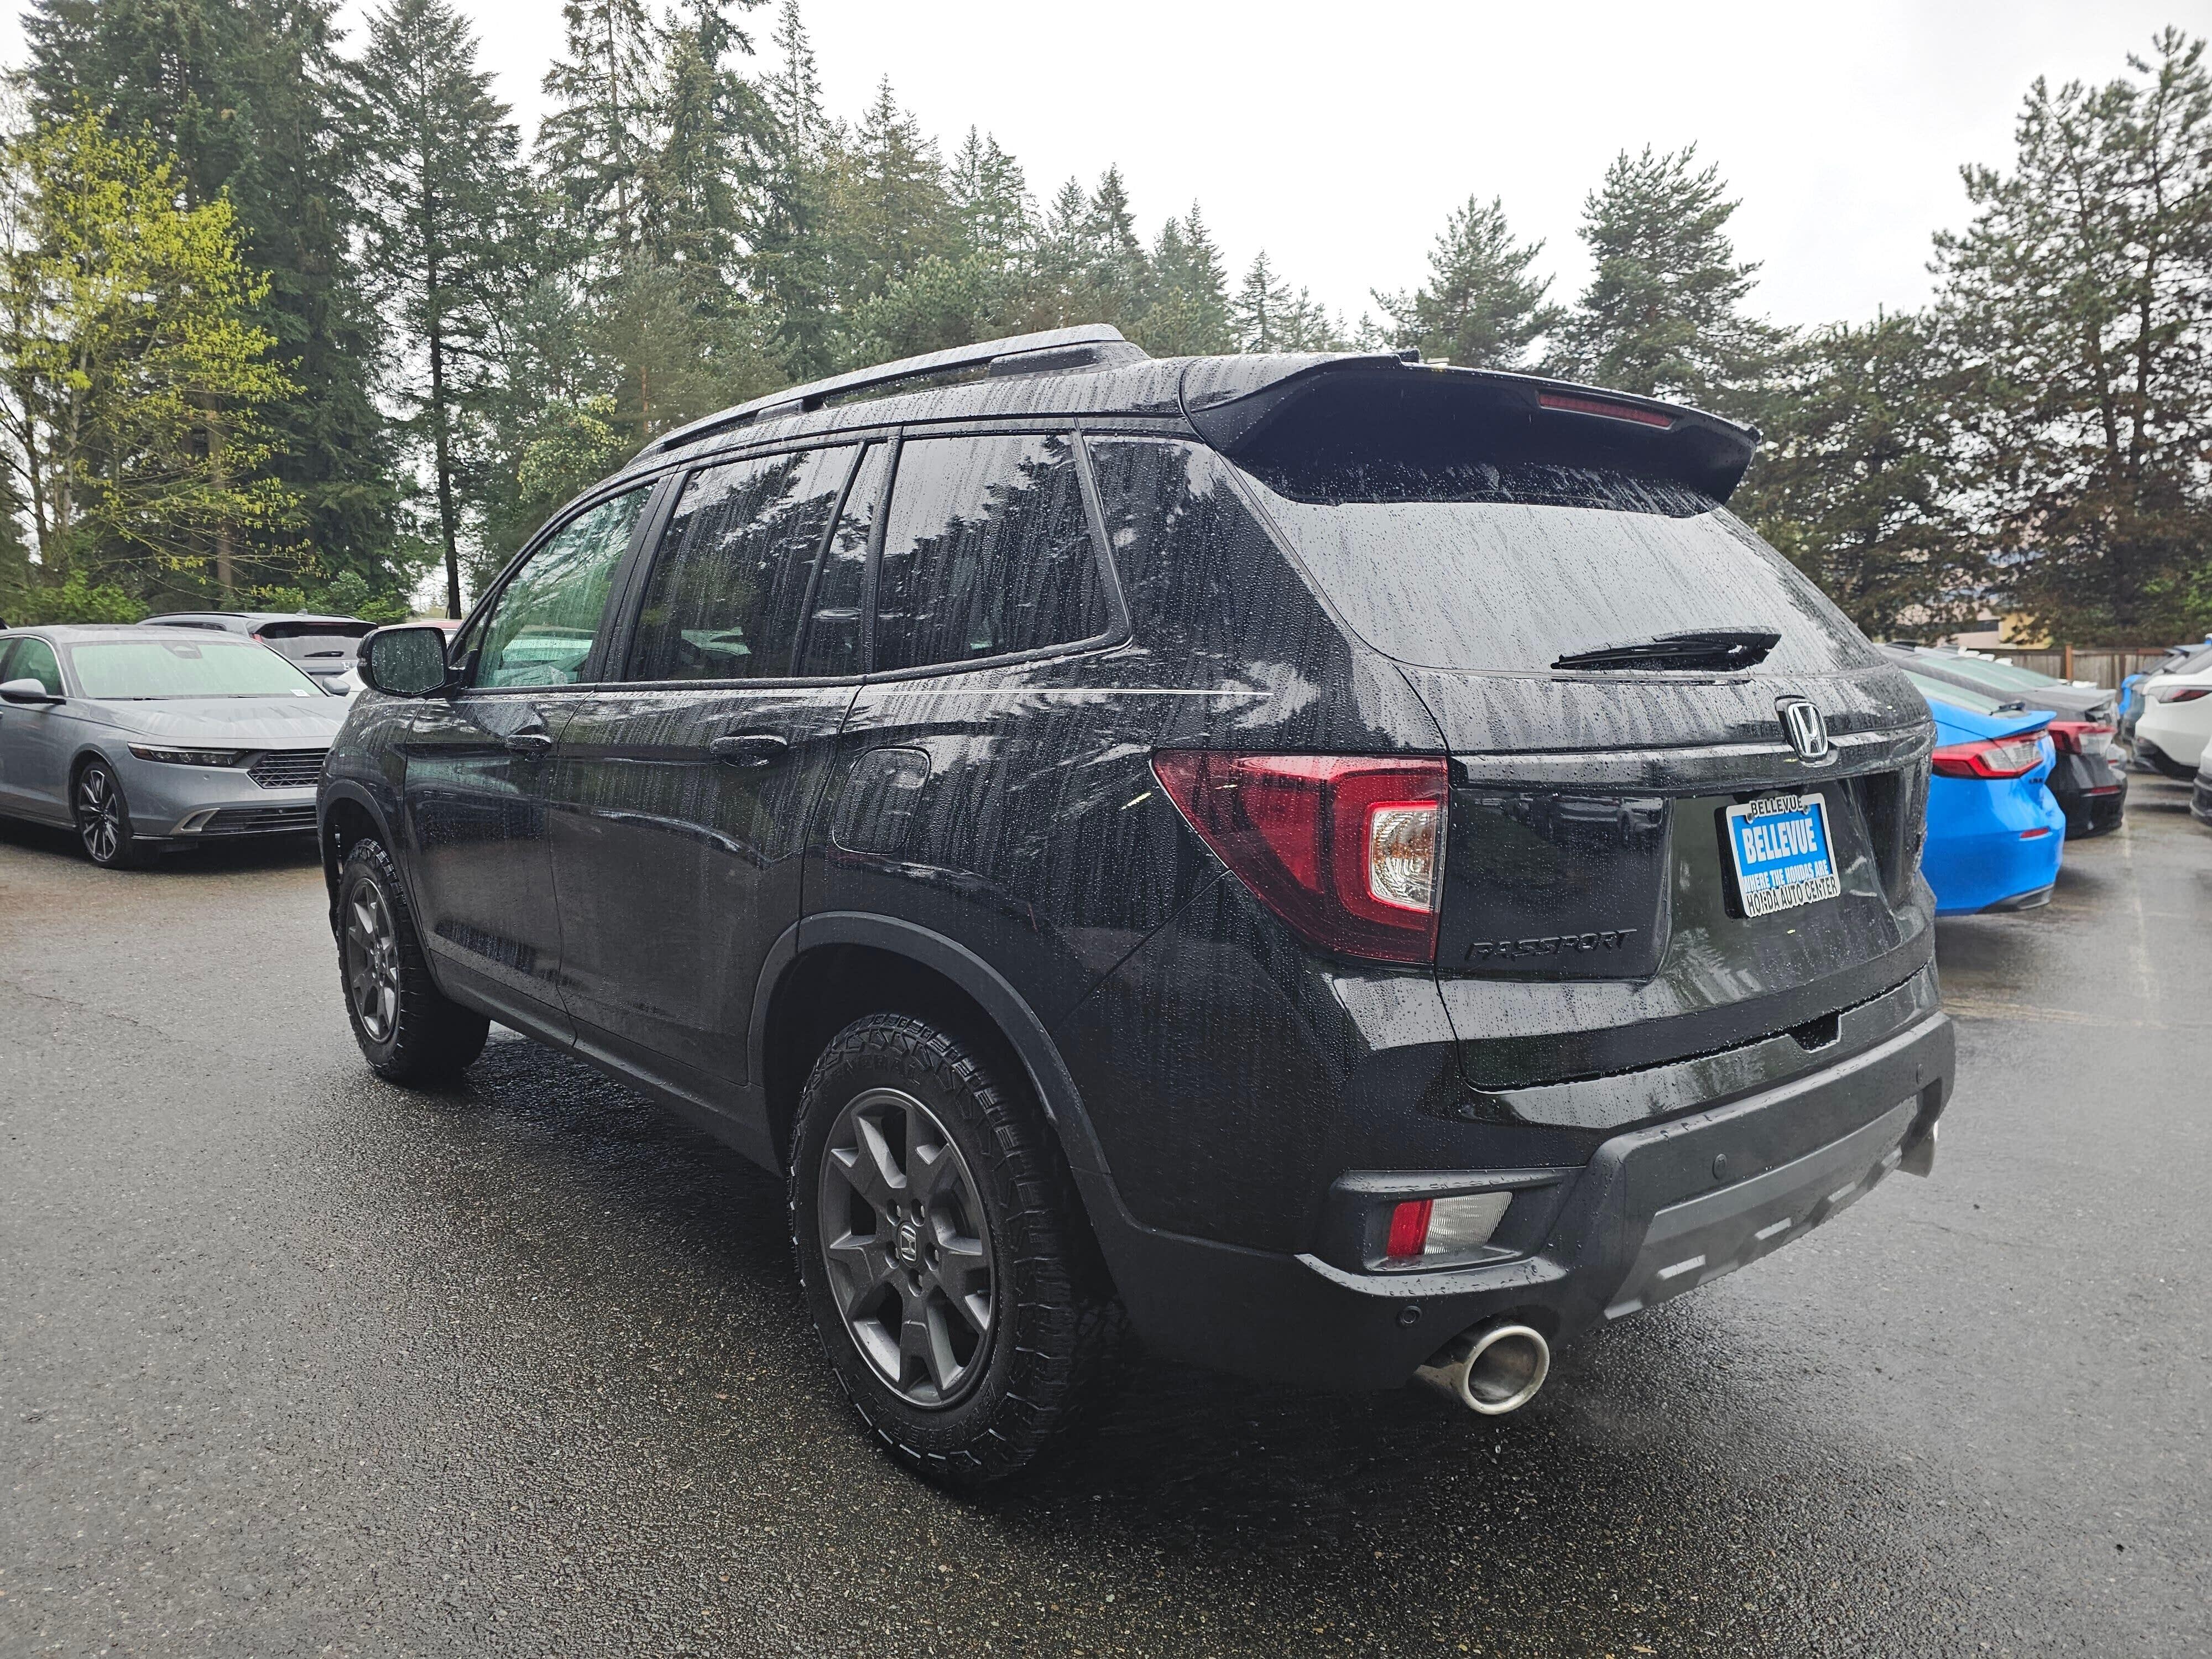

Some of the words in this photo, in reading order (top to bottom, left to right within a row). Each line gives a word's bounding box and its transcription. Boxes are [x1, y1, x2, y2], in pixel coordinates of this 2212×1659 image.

[1751, 796, 1803, 815] BELLEVUE
[1742, 818, 1817, 864] BELLEVUE
[1743, 872, 1770, 893] WHERE
[1770, 868, 1785, 886] THE
[1785, 862, 1814, 883] HONDAS
[1814, 859, 1829, 877] ARE
[1746, 889, 1780, 915] HONDA
[1780, 883, 1803, 906] AUTO
[1804, 876, 1838, 899] CENTER
[1465, 928, 1637, 961] PASSPORT
